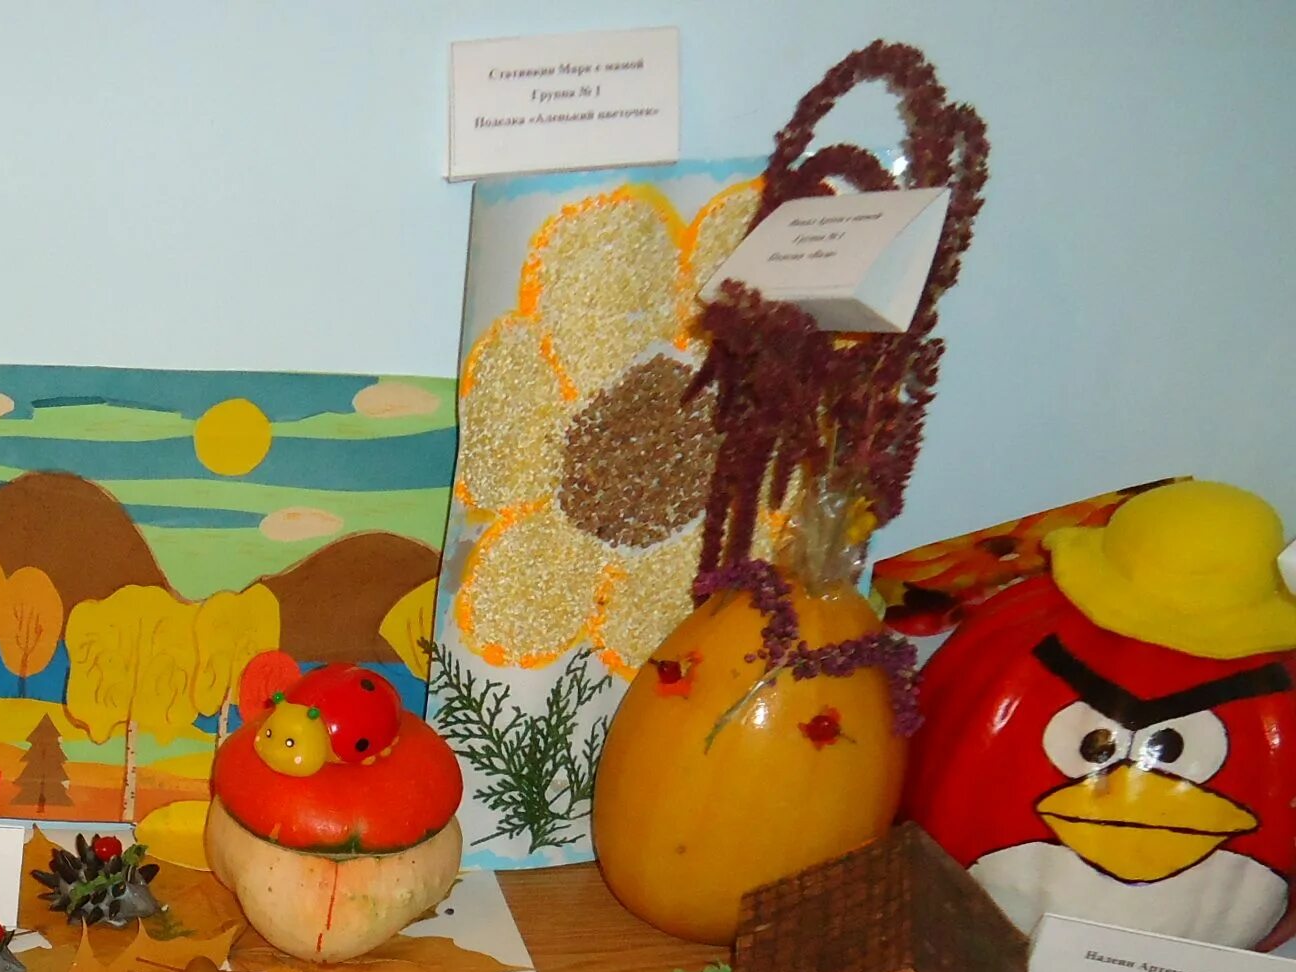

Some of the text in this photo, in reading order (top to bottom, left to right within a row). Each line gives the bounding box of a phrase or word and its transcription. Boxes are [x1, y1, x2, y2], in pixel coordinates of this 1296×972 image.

[531, 88, 576, 103] Группа
[595, 85, 601, 97] 1
[473, 116, 525, 129] Поделка
